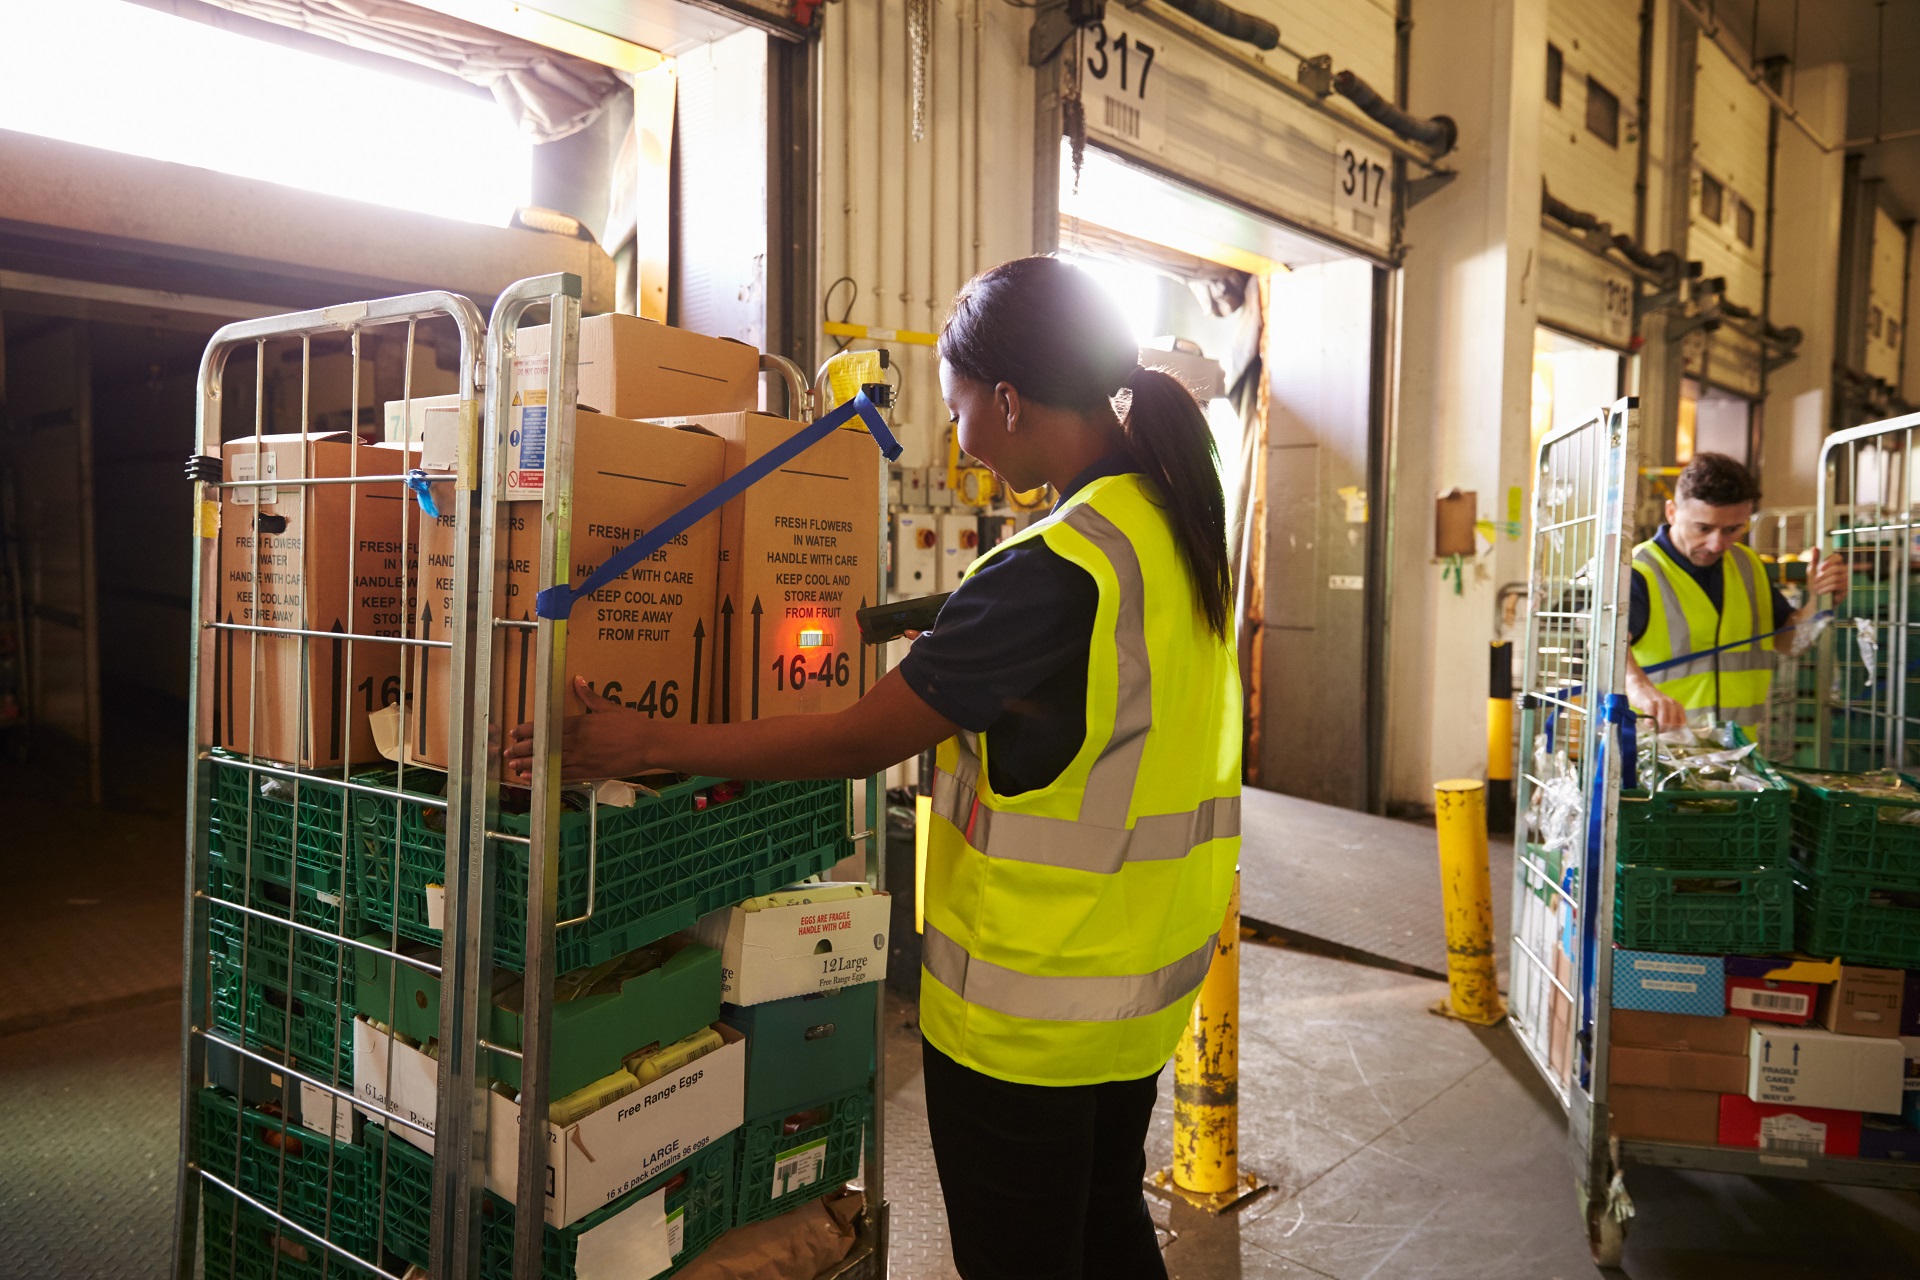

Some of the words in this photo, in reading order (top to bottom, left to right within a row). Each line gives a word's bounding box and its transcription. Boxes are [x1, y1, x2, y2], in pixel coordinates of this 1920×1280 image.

[1087, 22, 1154, 100] 317
[1342, 149, 1386, 208] 317
[436, 515, 455, 527] FRE
[775, 516, 808, 530] FRESH
[809, 519, 853, 533] FLOWERS
[589, 524, 630, 540] FRESH
[633, 529, 688, 546] FLRS
[793, 534, 803, 546] IN
[805, 535, 837, 548] WATER
[360, 541, 402, 553] FRESH
[260, 554, 288, 566] WATER
[384, 559, 396, 569] IN
[428, 554, 455, 567] HAND
[507, 560, 530, 573] ARE
[767, 552, 808, 565] HANDLE
[810, 553, 833, 566] WITH
[834, 555, 858, 567] CARE
[229, 571, 262, 583] HANDE
[264, 573, 284, 585] WITH
[632, 568, 661, 582] WITH
[664, 571, 694, 584] CARE
[776, 573, 803, 585] KEEP
[805, 574, 830, 586] COOL
[832, 575, 850, 586] AND
[436, 578, 454, 590] KEE
[237, 592, 253, 602] KEE
[260, 593, 282, 605] COOL
[284, 595, 300, 606] AND
[362, 597, 396, 608] KEEP
[587, 590, 621, 602] KEEP
[624, 591, 657, 605] COOL
[660, 593, 683, 606] AND
[784, 590, 817, 602] STORE
[818, 591, 843, 602] AWAY
[271, 611, 294, 622] AWAY
[597, 609, 638, 622] STORE
[641, 611, 673, 623] AWAY
[785, 607, 814, 619] FROM
[816, 607, 841, 618] FRUIT
[598, 628, 634, 641] FROM
[638, 629, 670, 641] FRUIT
[772, 652, 850, 691] 16-46
[358, 675, 413, 711] 16-
[801, 915, 816, 925] EGGS
[816, 914, 828, 924] ARE
[829, 911, 851, 922] FRAGILE
[798, 925, 821, 936] HANDLE
[822, 923, 837, 932] WITH
[838, 920, 852, 930] CARE
[822, 958, 837, 974] 12
[837, 956, 868, 973] Large
[819, 978, 833, 987] Free
[833, 975, 851, 986] Range
[851, 972, 866, 982] Eggs
[721, 982, 732, 992] ggs
[1762, 1066, 1799, 1076] FRAGILE
[1765, 1076, 1796, 1084] CAKES
[365, 1083, 372, 1096] 6
[617, 1105, 641, 1122] Free
[644, 1085, 676, 1109] Range
[679, 1069, 704, 1090] Eggs
[1770, 1085, 1790, 1093] THIS
[1762, 1093, 1780, 1101] WAY
[642, 1139, 680, 1169] LARGE
[606, 1191, 616, 1201] 16
[617, 1186, 622, 1195] x
[624, 1181, 629, 1190] 6
[630, 1171, 649, 1190] pack
[650, 1152, 681, 1176] contains
[682, 1145, 692, 1156] 96
[692, 1136, 710, 1152] eggs
